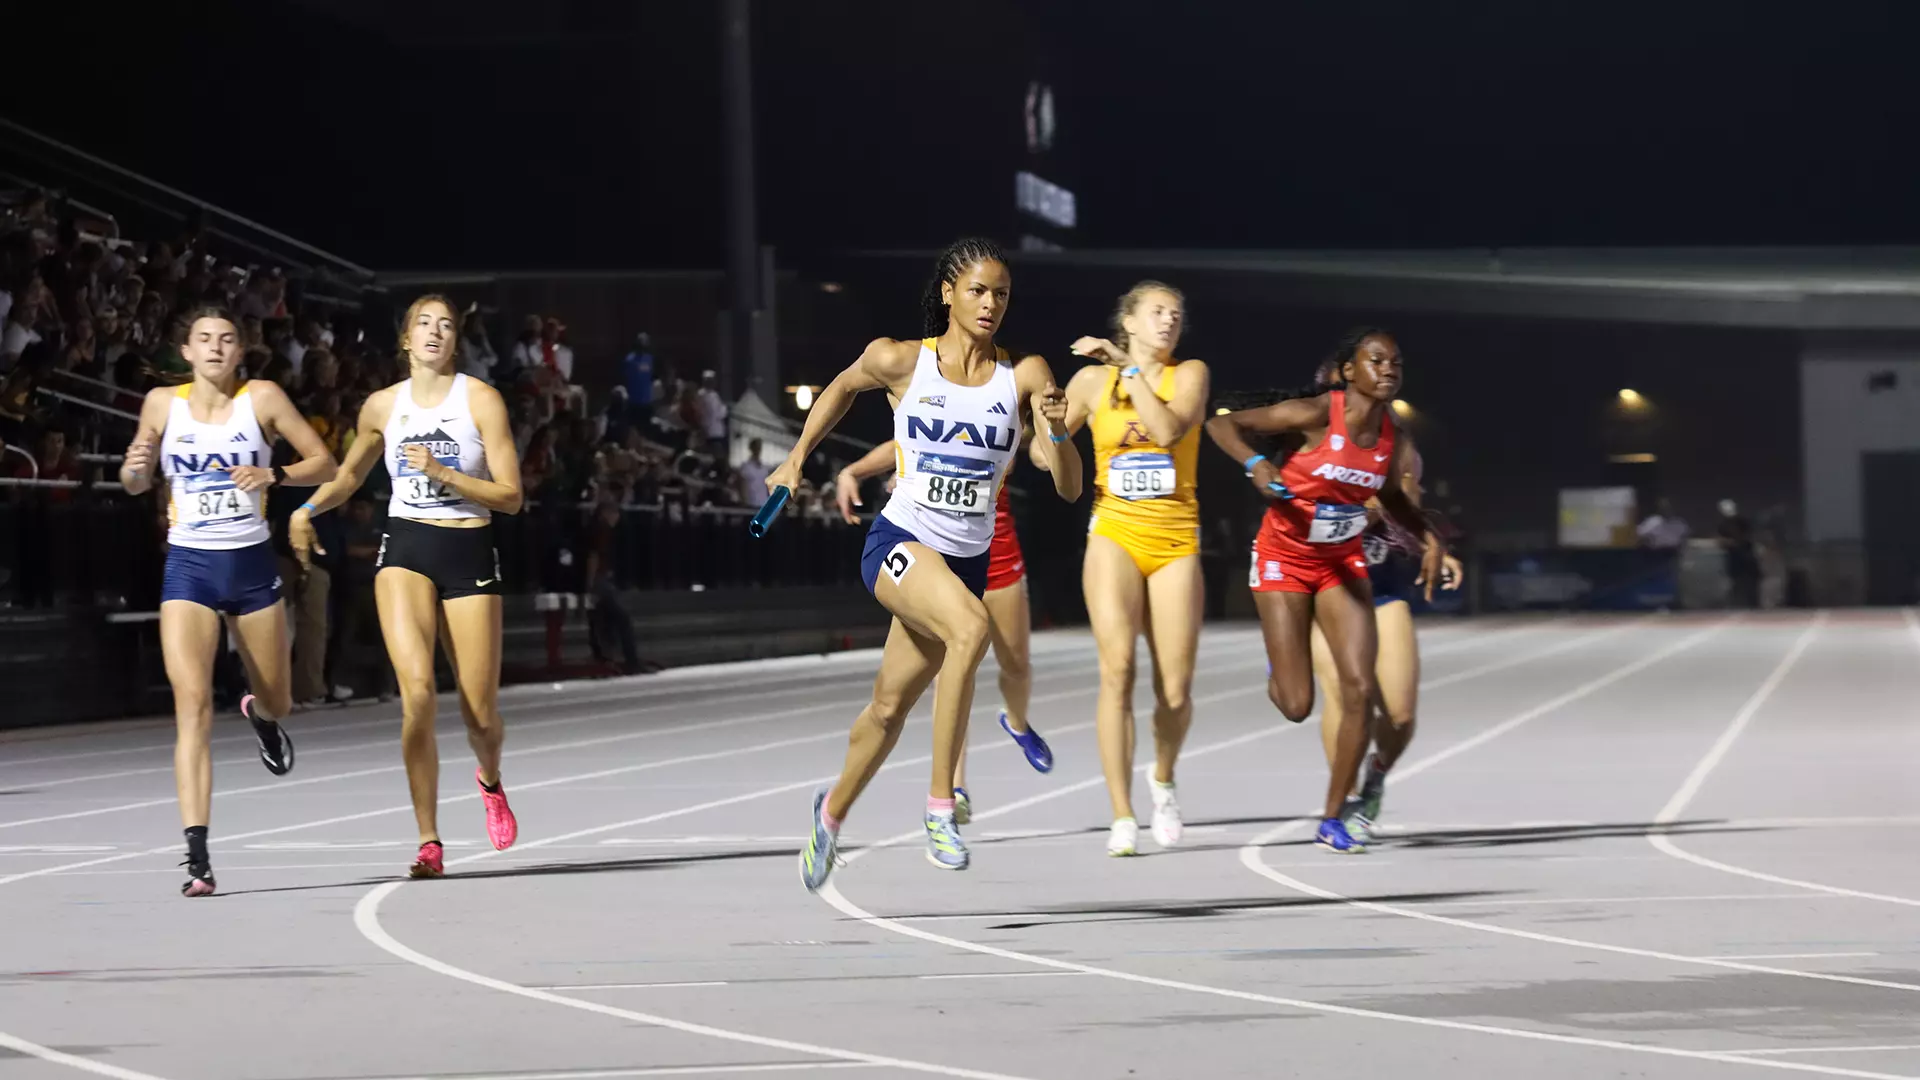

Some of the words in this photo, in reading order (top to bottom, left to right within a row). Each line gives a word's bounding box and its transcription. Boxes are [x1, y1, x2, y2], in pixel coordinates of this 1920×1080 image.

[907, 415, 1016, 452] NAU
[168, 450, 259, 473] NAU
[409, 478, 451, 499] 312
[927, 476, 980, 507] 885
[1122, 470, 1162, 492] 696
[198, 489, 240, 516] 874
[884, 551, 909, 578] 5
